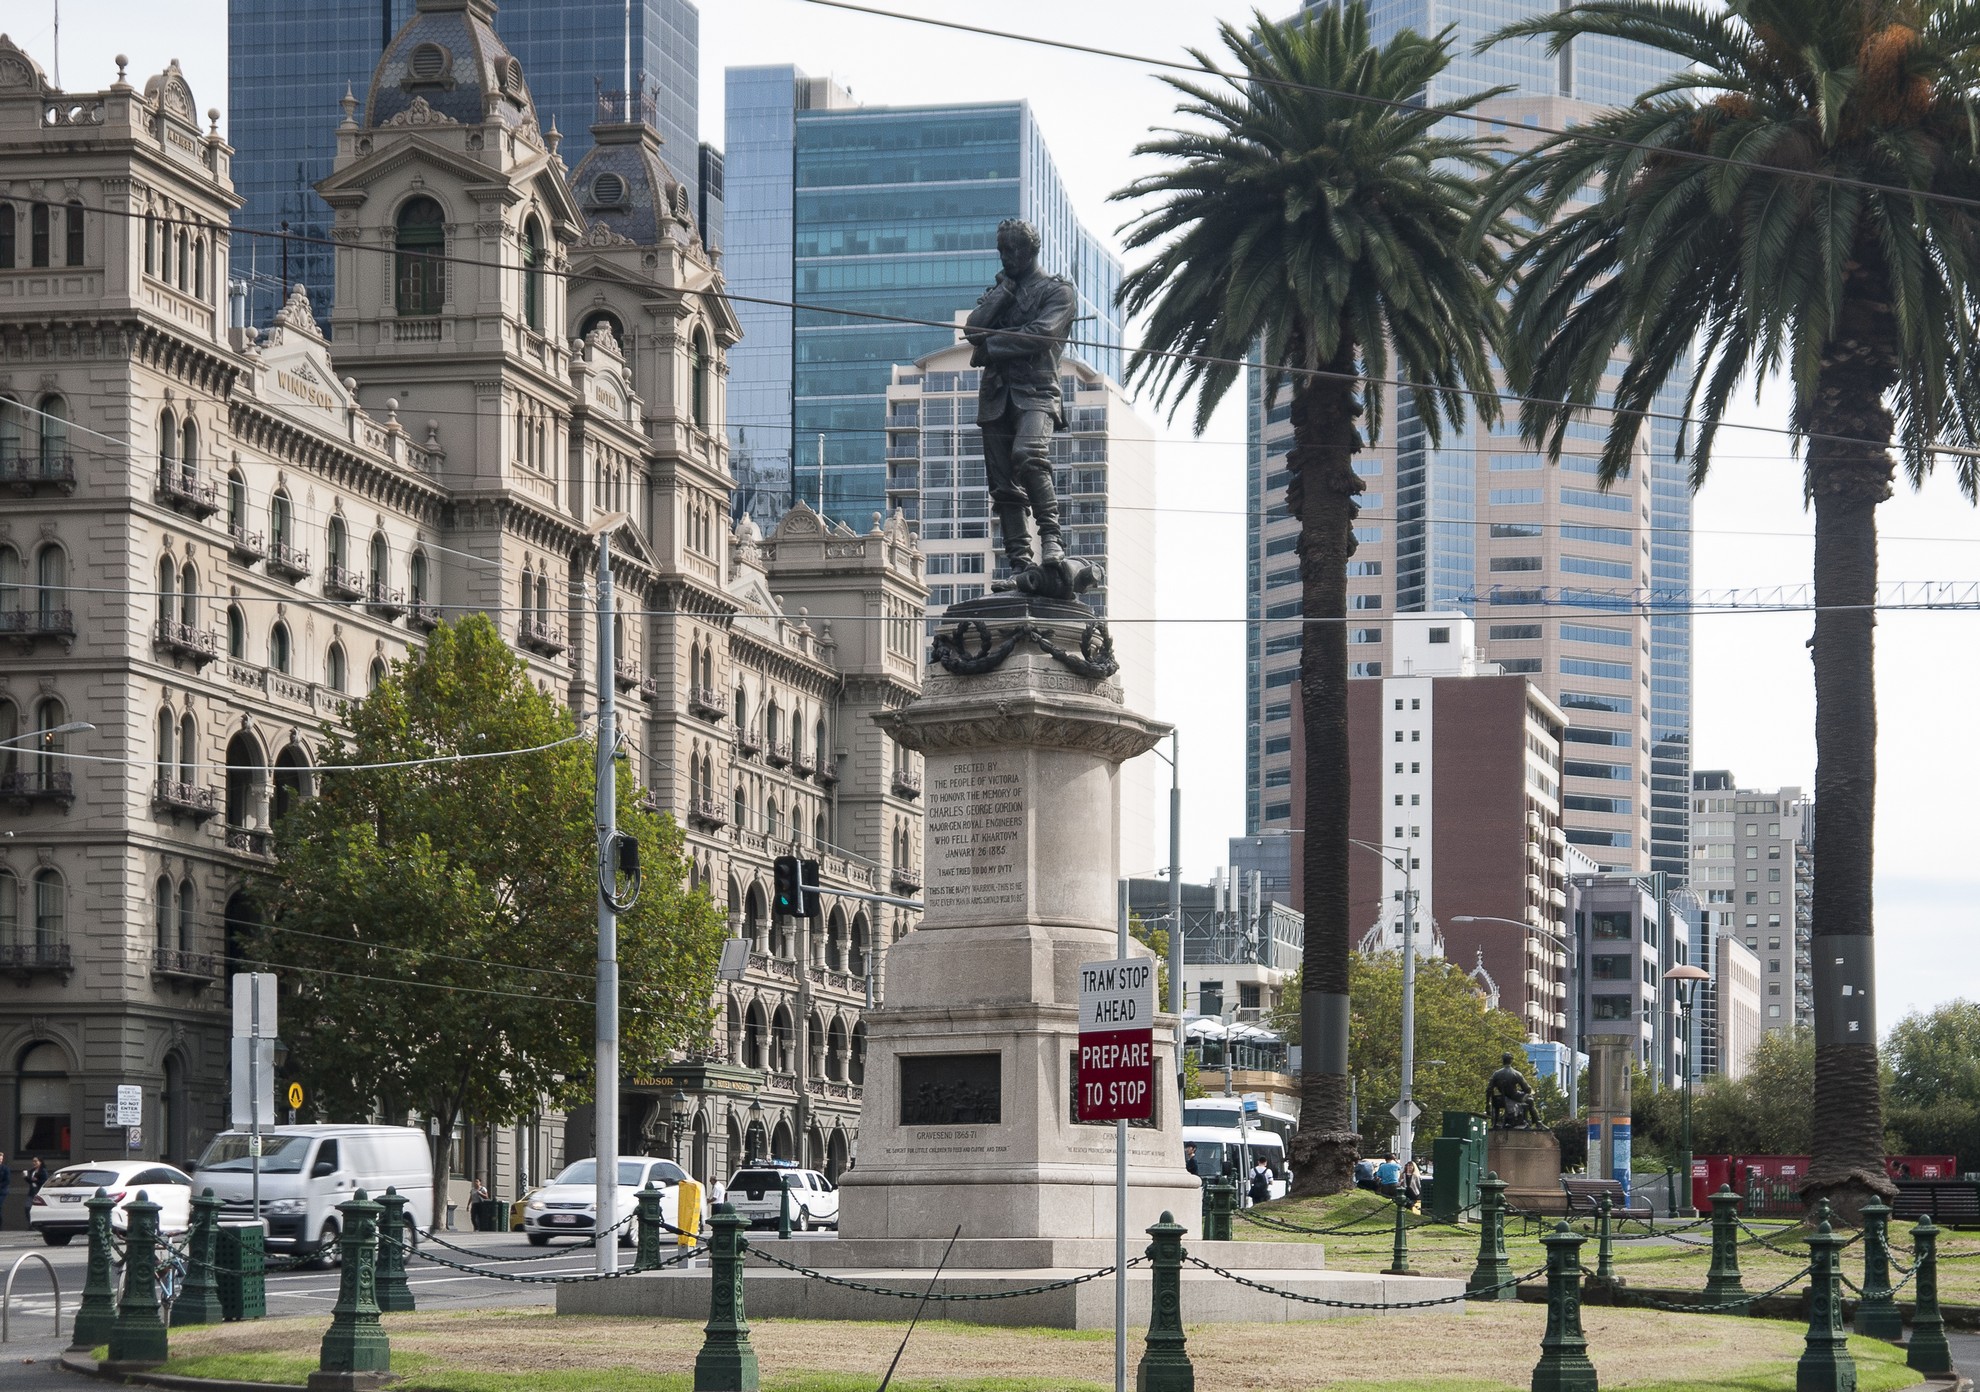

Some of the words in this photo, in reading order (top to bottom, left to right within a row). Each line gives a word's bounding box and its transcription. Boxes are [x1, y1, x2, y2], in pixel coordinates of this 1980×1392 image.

[277, 369, 333, 413] WINDSOR
[596, 385, 618, 412] HOTEL
[954, 763, 984, 774] ERECTED
[988, 762, 997, 771] BY
[935, 779, 947, 789] THE
[950, 777, 975, 788] PEOPLE
[977, 776, 986, 786] OF
[988, 774, 1019, 785] VICTORIA
[930, 794, 938, 803] TO
[967, 791, 980, 800] THE
[982, 788, 1011, 799] MEMORY
[1013, 787, 1022, 797] OF
[929, 806, 963, 818] CHARLES
[966, 803, 992, 816] GEORGE
[994, 801, 1022, 814] GORDON
[962, 820, 983, 829] ROYAL
[986, 817, 1022, 828] ENGINEERS
[934, 836, 949, 845] WHO
[951, 834, 968, 844] FELL
[971, 833, 979, 843] AT
[978, 847, 986, 856] 26
[941, 867, 955, 877] HAVE
[956, 867, 970, 876] TRIED
[972, 866, 979, 875] TO
[980, 866, 987, 874] DO
[988, 865, 996, 874] MY
[1082, 968, 1115, 992] TRAM
[1119, 966, 1149, 990] STOP
[1095, 998, 1136, 1023] AHEAD
[1082, 1043, 1149, 1069] PREPARE
[633, 1077, 674, 1086] WINDSOR
[1085, 1082, 1103, 1106] TO
[1109, 1080, 1146, 1105] STOP
[916, 1131, 952, 1140] GRAVESEND
